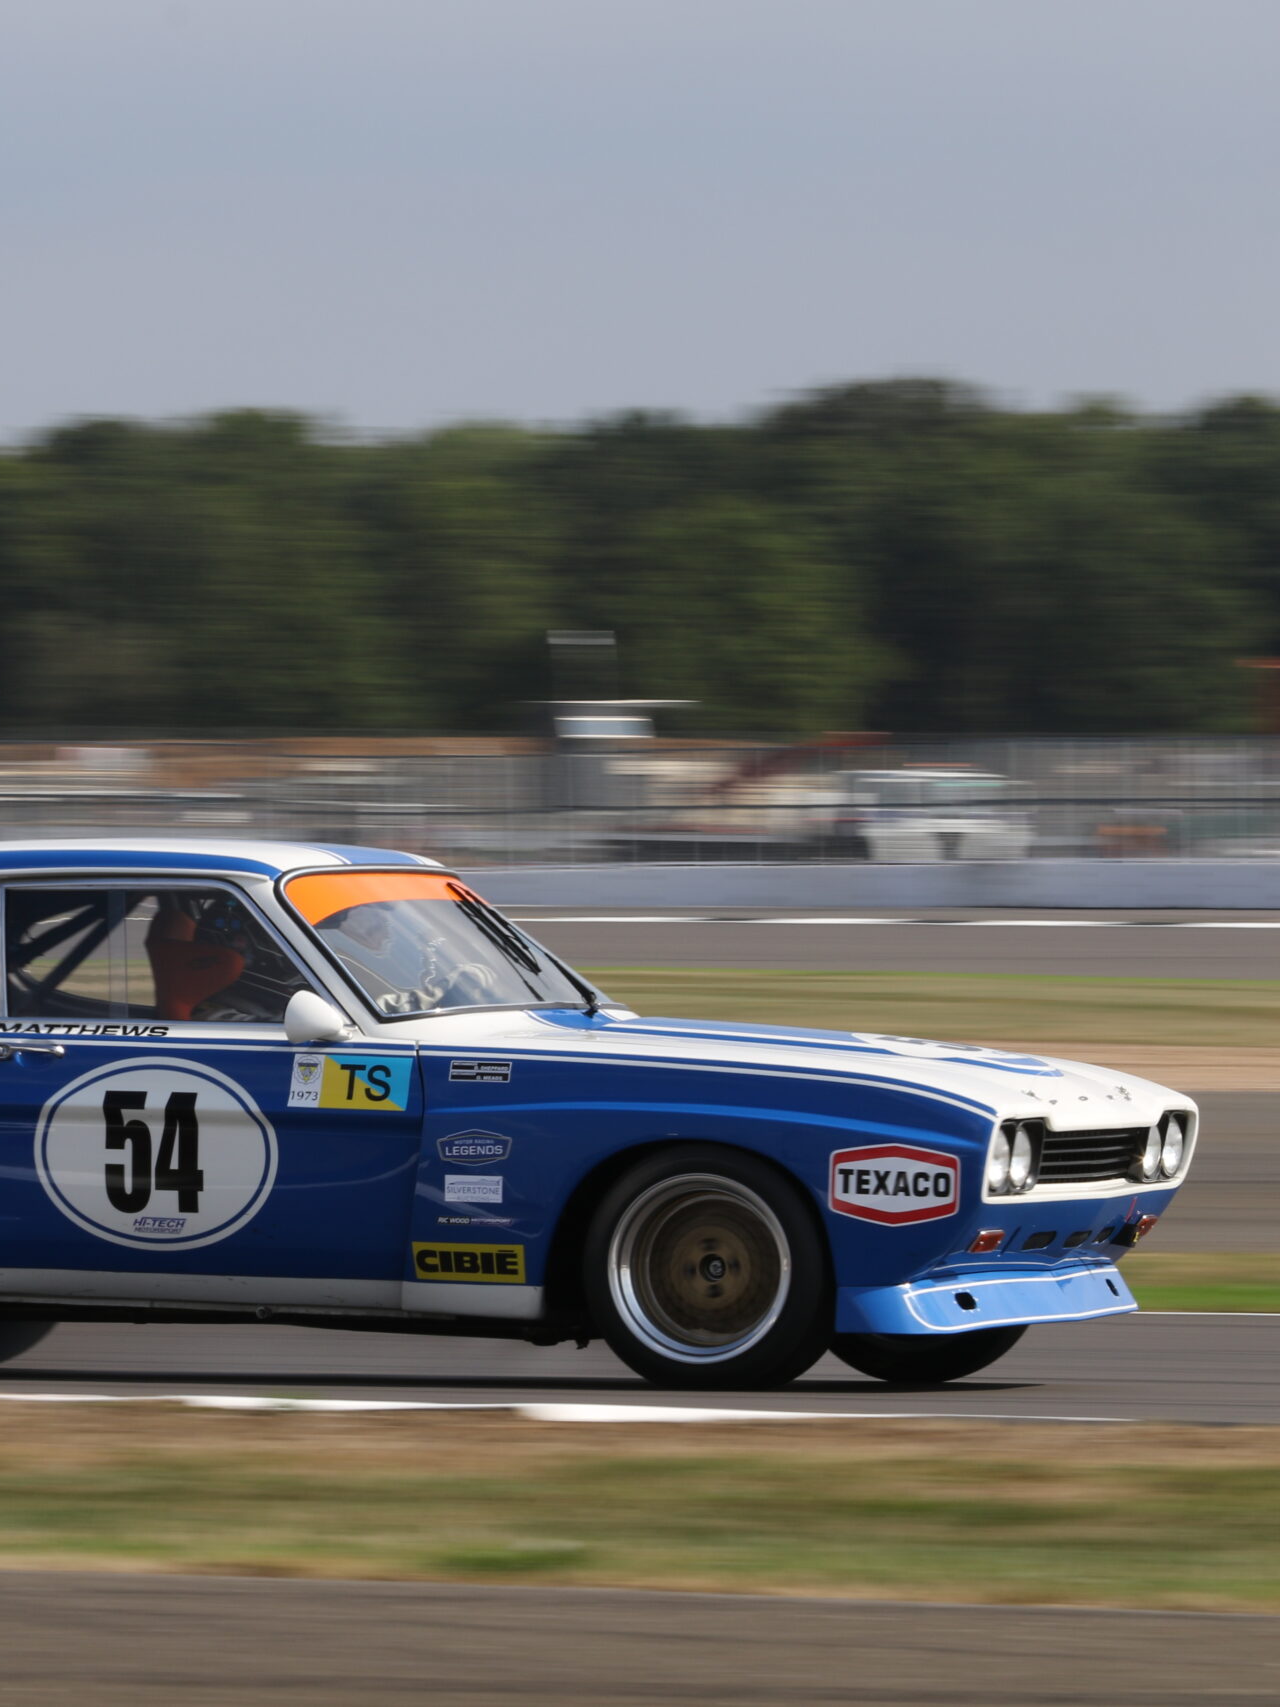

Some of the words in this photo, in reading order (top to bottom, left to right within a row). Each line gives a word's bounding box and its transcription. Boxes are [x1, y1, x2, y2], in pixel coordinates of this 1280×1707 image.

[340, 1063, 392, 1103] TS
[290, 1090, 319, 1101] 1973
[103, 1090, 204, 1214] 54
[445, 1145, 503, 1156] LEGENDS
[838, 1167, 951, 1199] TEXACO
[446, 1185, 501, 1196] SILVERSTONE
[133, 1216, 187, 1228] HI-TECH
[449, 1216, 470, 1224] WOOD
